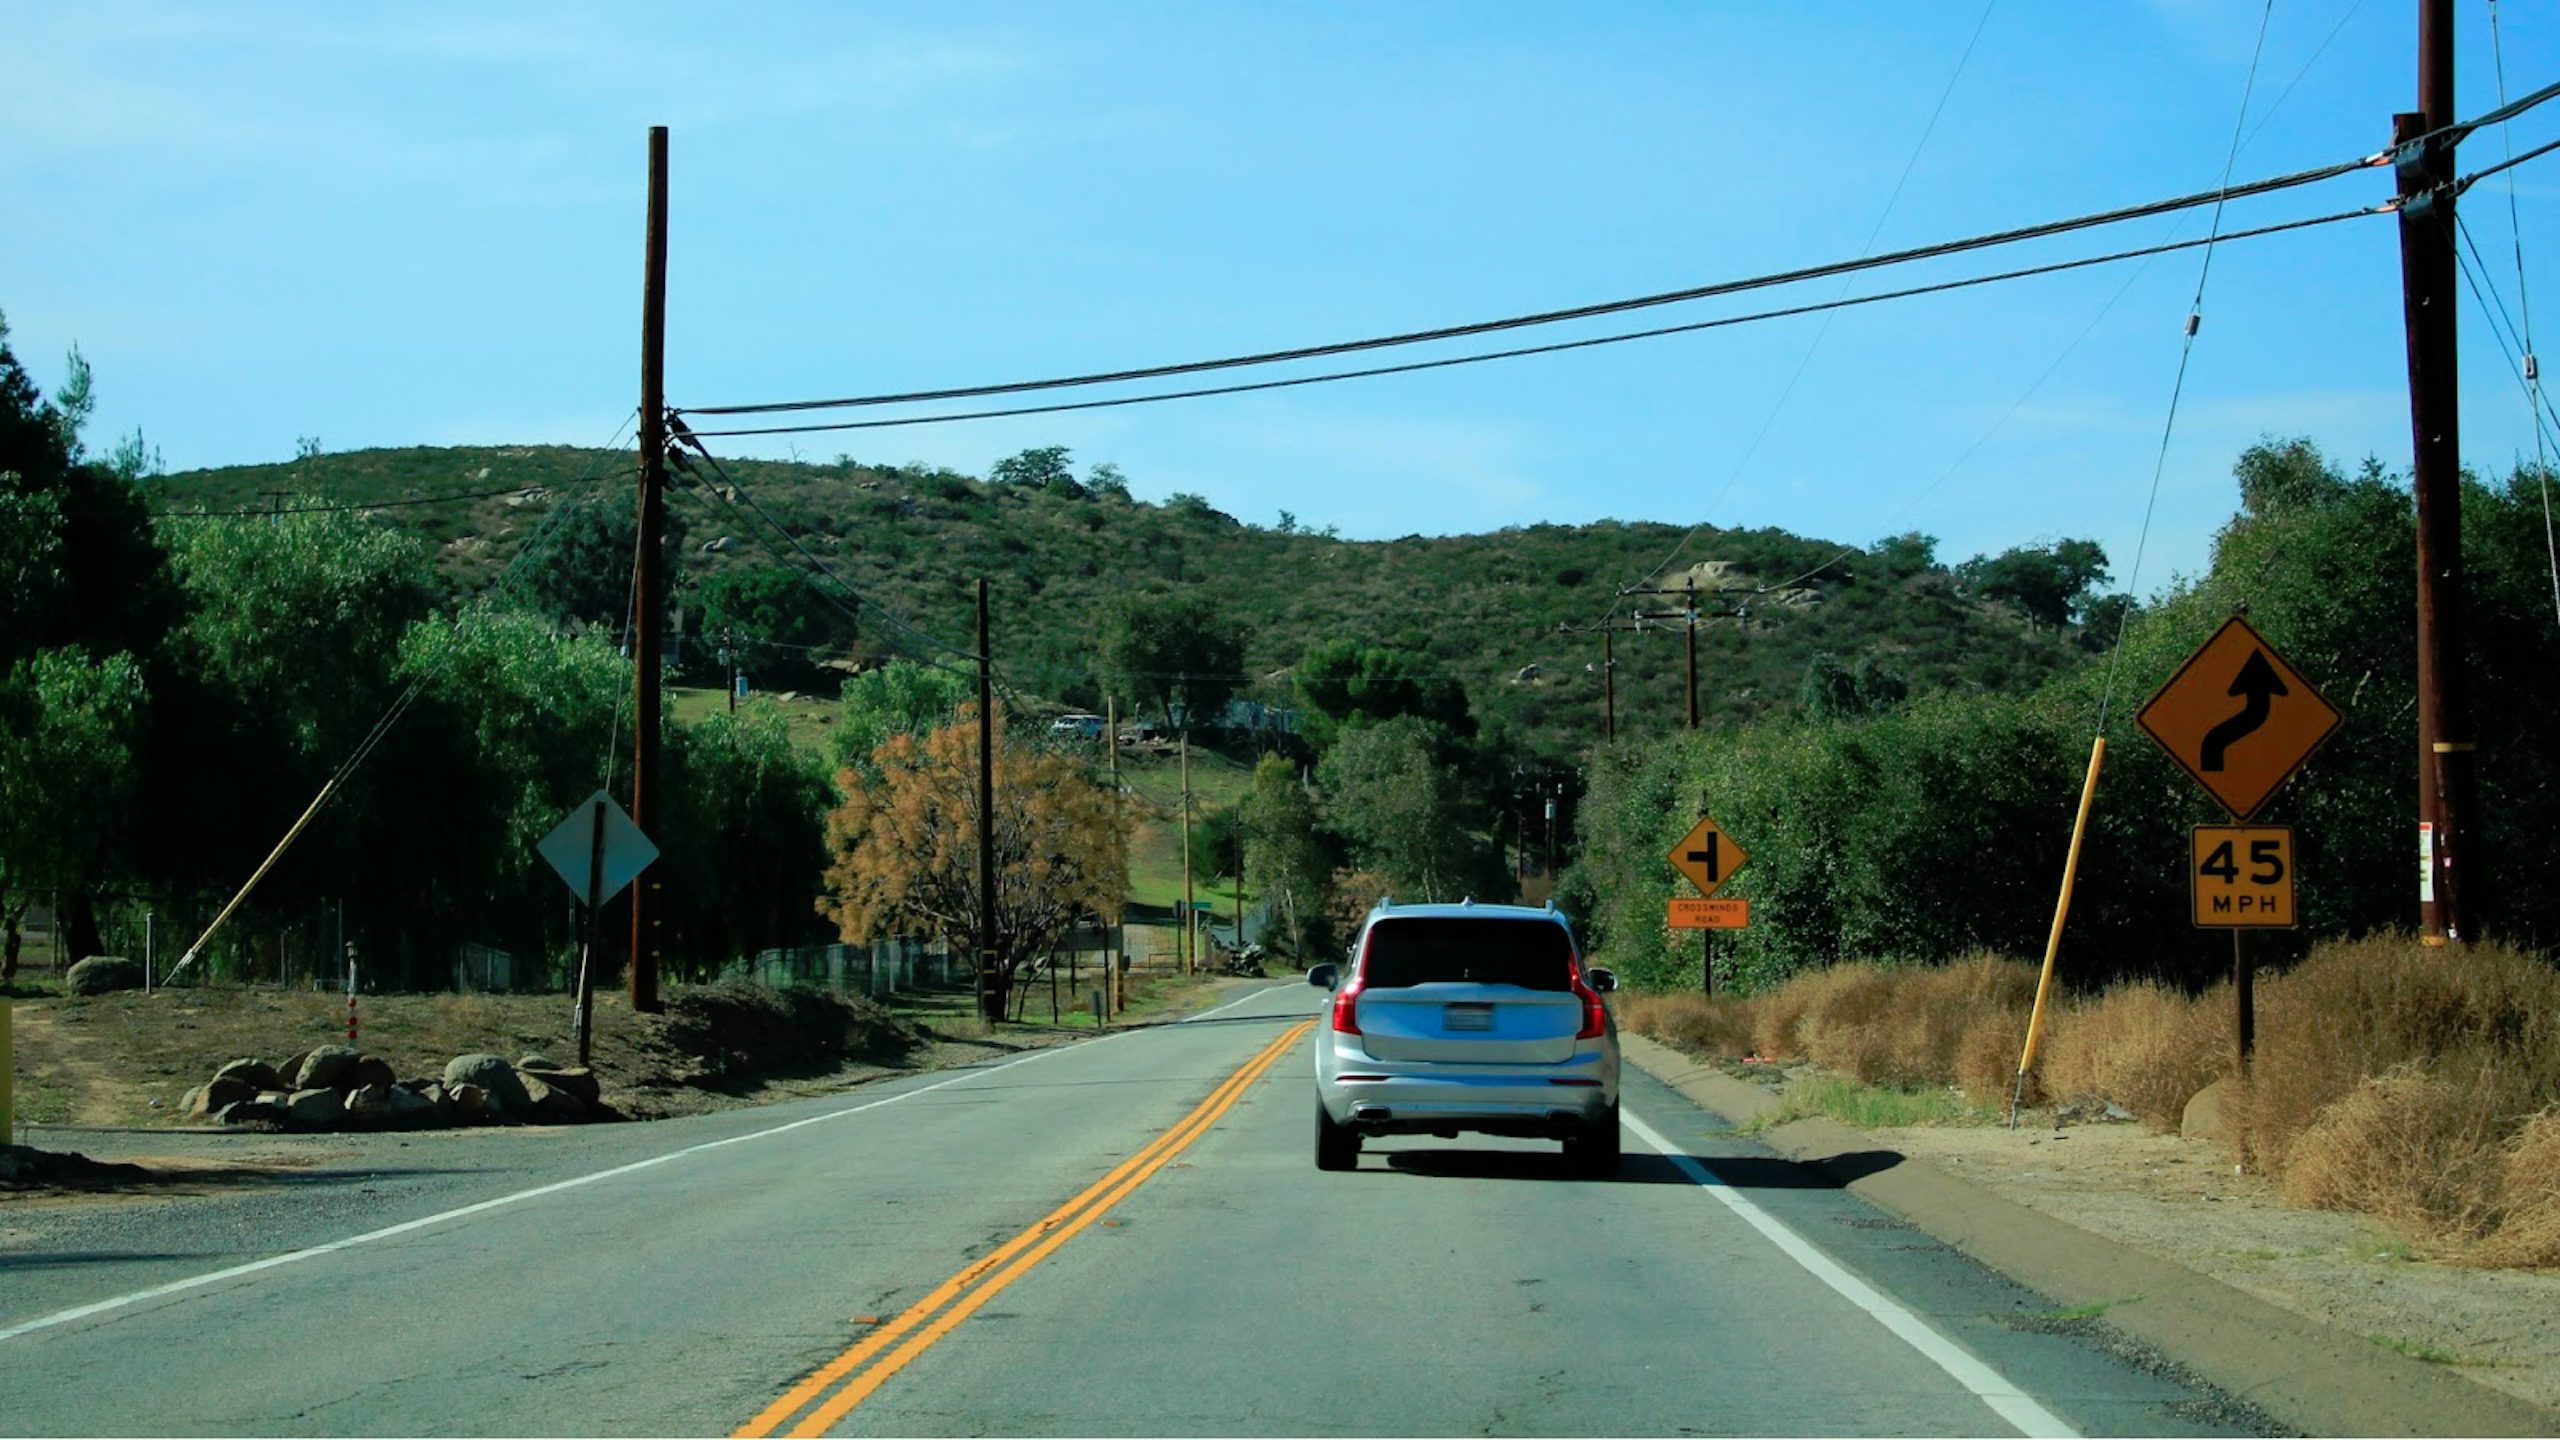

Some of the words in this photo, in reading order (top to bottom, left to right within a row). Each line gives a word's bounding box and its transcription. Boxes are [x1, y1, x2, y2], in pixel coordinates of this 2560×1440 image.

[2200, 839, 2284, 885] 45
[2212, 895, 2276, 913] MPH
[1695, 915, 1721, 924] ROAD
